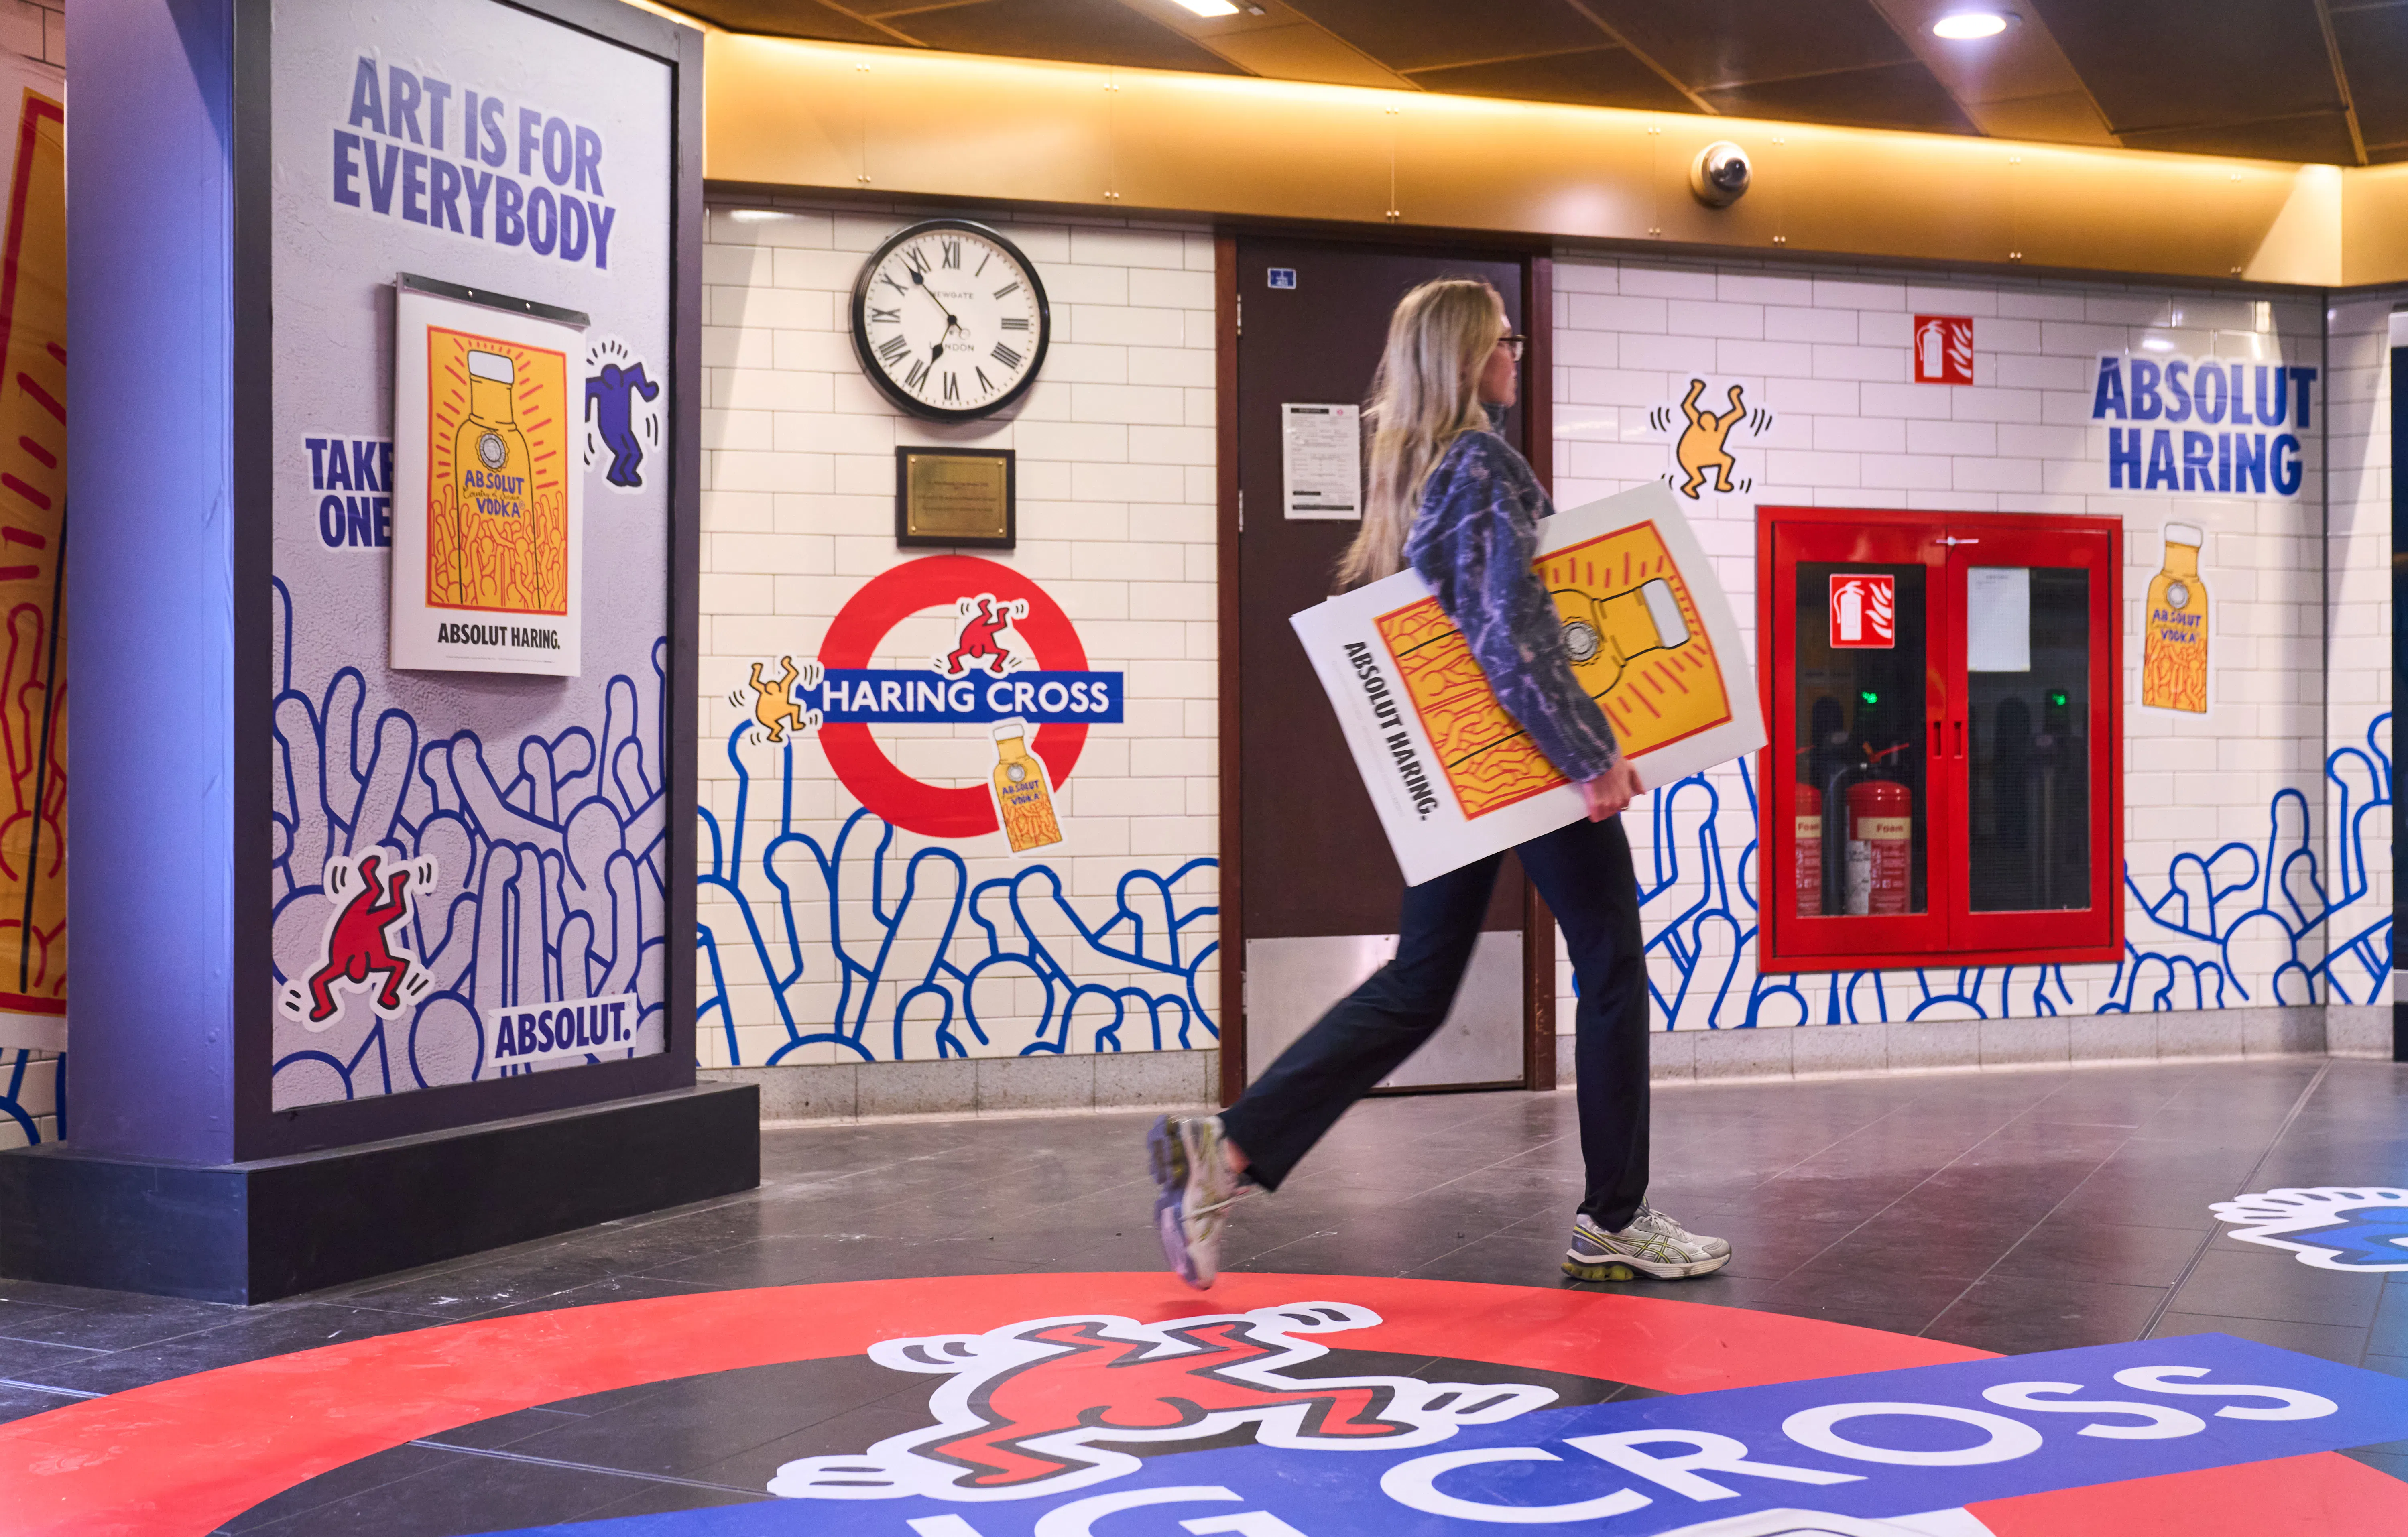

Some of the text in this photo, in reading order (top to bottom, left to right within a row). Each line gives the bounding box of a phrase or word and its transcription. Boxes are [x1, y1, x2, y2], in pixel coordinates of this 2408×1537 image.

[348, 55, 605, 198] ART IS FOR
[334, 128, 616, 270] EVERYBODY
[929, 341, 974, 352] LNDON
[2092, 357, 2317, 429] ABSOLUT
[305, 438, 393, 492] TAKE
[464, 470, 525, 495] ABSOLUT
[2109, 427, 2303, 496] HARING
[319, 494, 392, 548] ONE
[476, 498, 521, 518] VODKA
[438, 623, 561, 650] ABSOLUT HARING.
[2152, 608, 2202, 628] ABSOLUT
[822, 680, 1109, 713] HARING CROSS
[1344, 641, 1404, 730] ABSOLUT
[1385, 730, 1440, 822] HARING.
[1002, 779, 1039, 795] ABSOLUT
[1876, 823, 1904, 833] Foam
[495, 1002, 631, 1058] ABSOLUT.
[1379, 1365, 2339, 1524] CROSS
